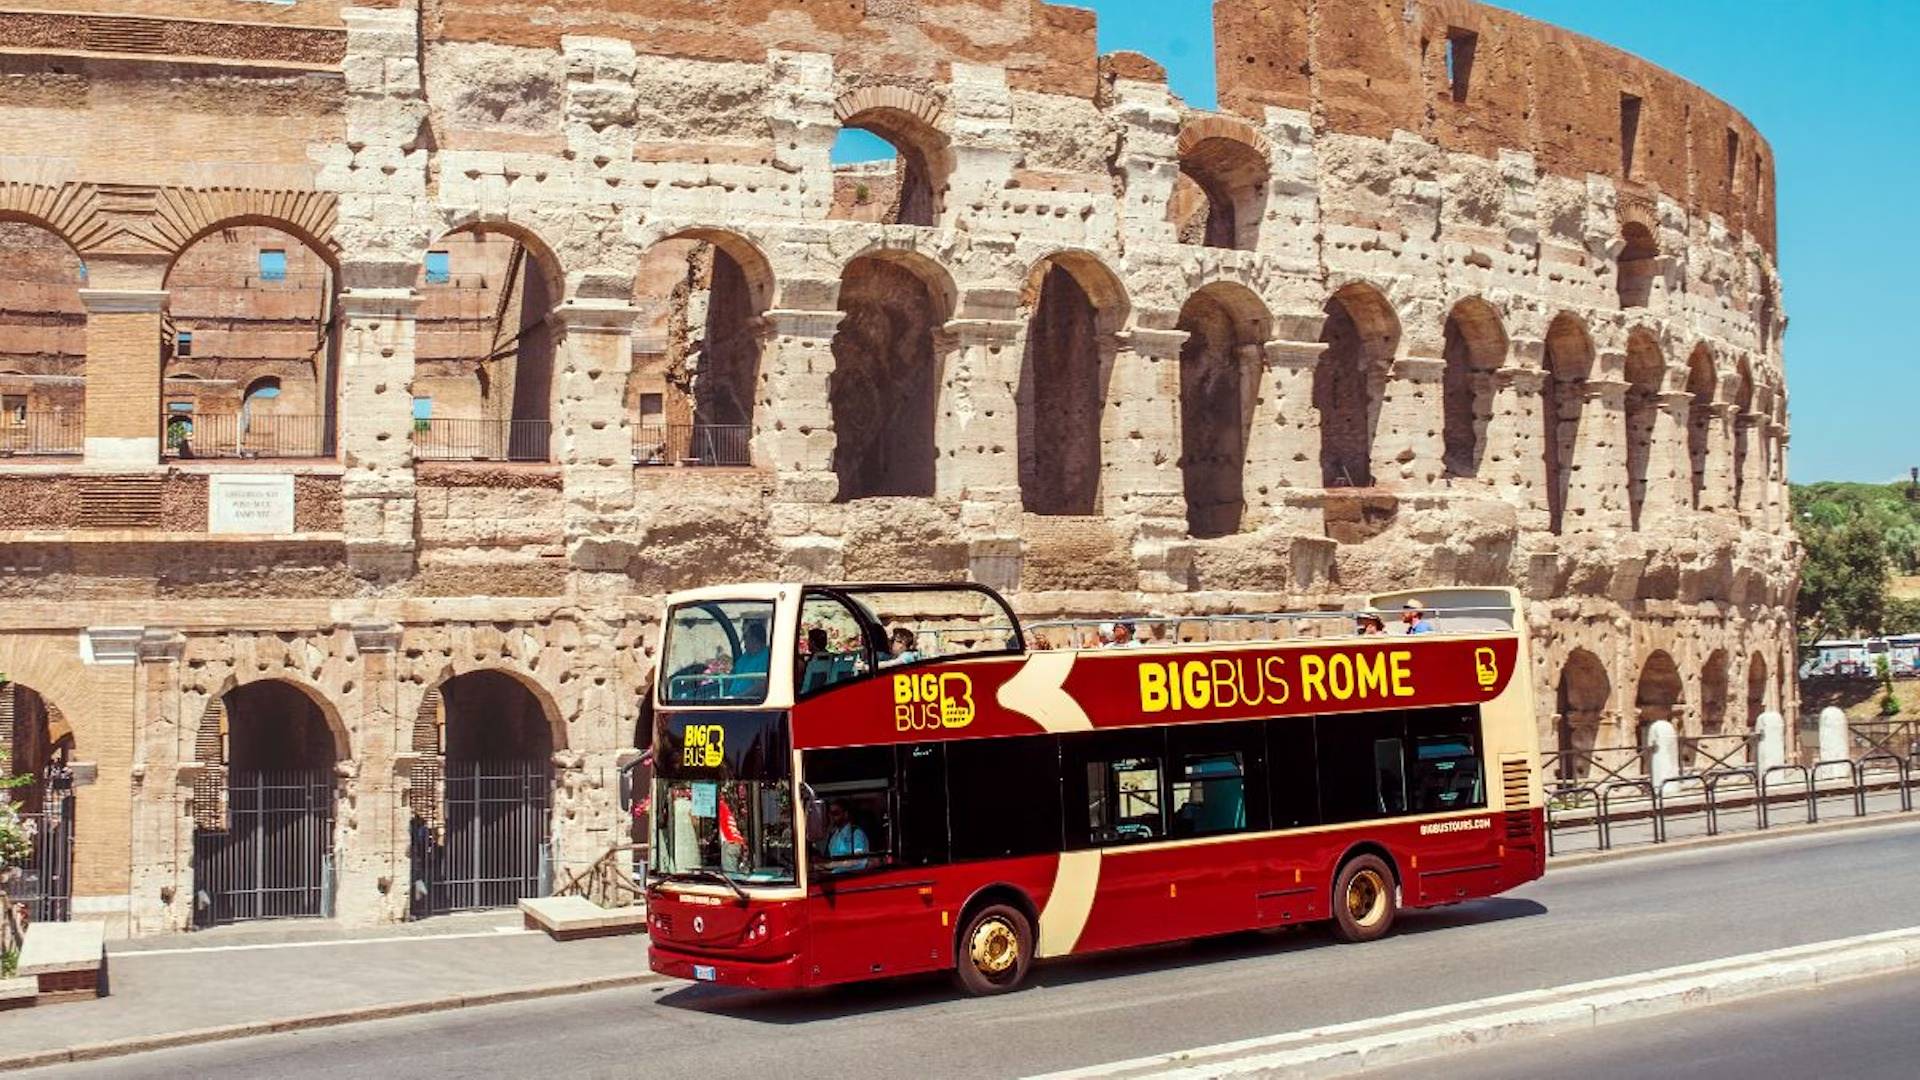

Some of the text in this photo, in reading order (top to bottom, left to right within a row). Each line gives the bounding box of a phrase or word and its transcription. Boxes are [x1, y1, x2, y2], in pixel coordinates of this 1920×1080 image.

[894, 673, 939, 704] BIG
[1300, 651, 1415, 702] ROME
[896, 703, 941, 731] BUS
[684, 725, 706, 747] BIG
[684, 747, 705, 766] BUS
[1420, 818, 1491, 835] BIGBUSTOURS.COM
